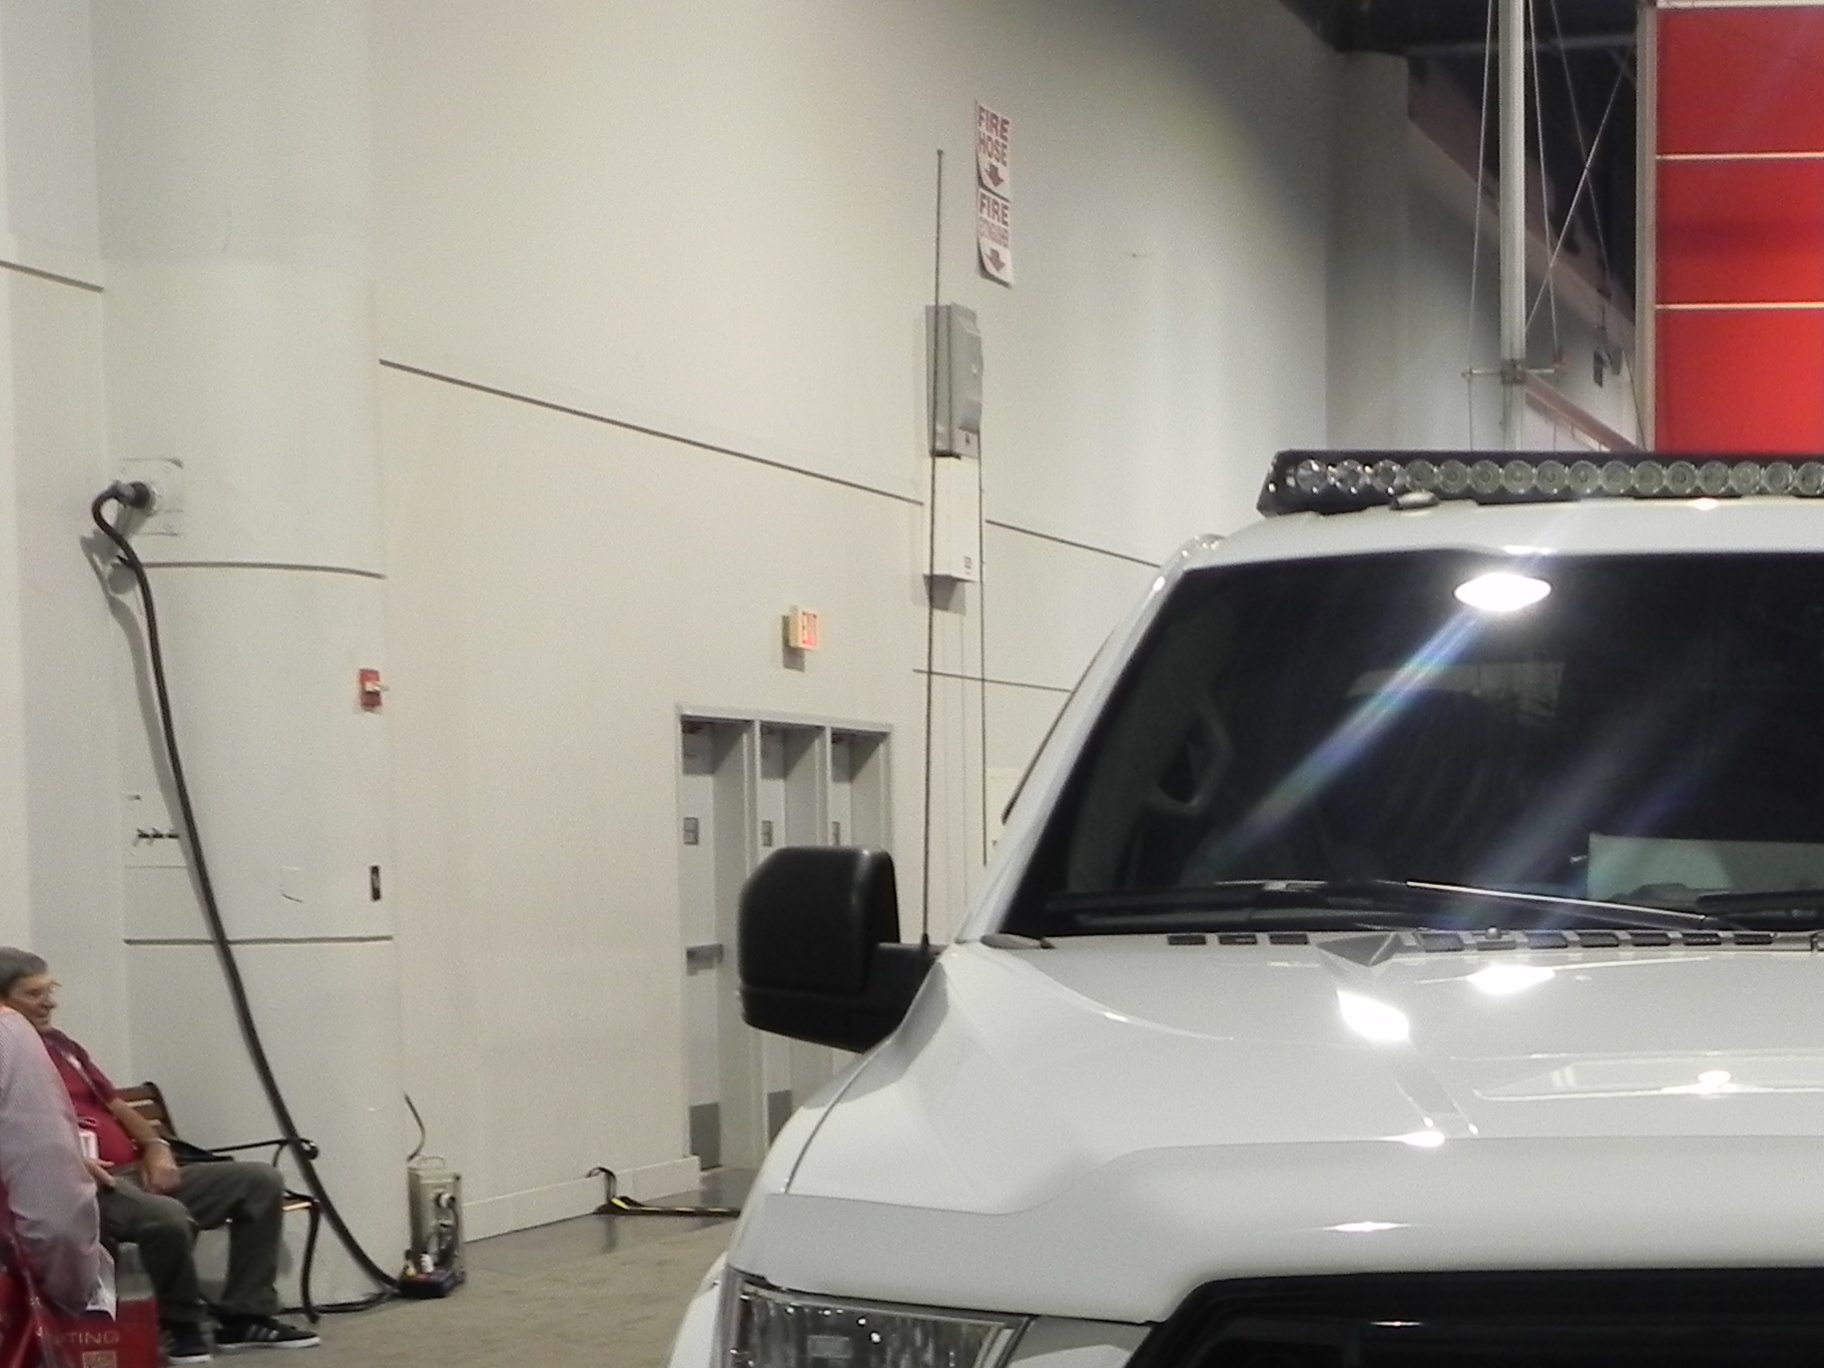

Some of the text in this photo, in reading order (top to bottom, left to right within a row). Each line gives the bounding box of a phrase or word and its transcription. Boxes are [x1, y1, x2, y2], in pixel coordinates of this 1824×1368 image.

[979, 105, 1010, 143] FIRE
[979, 131, 1009, 167] HOSE
[979, 193, 1010, 227] FIRE
